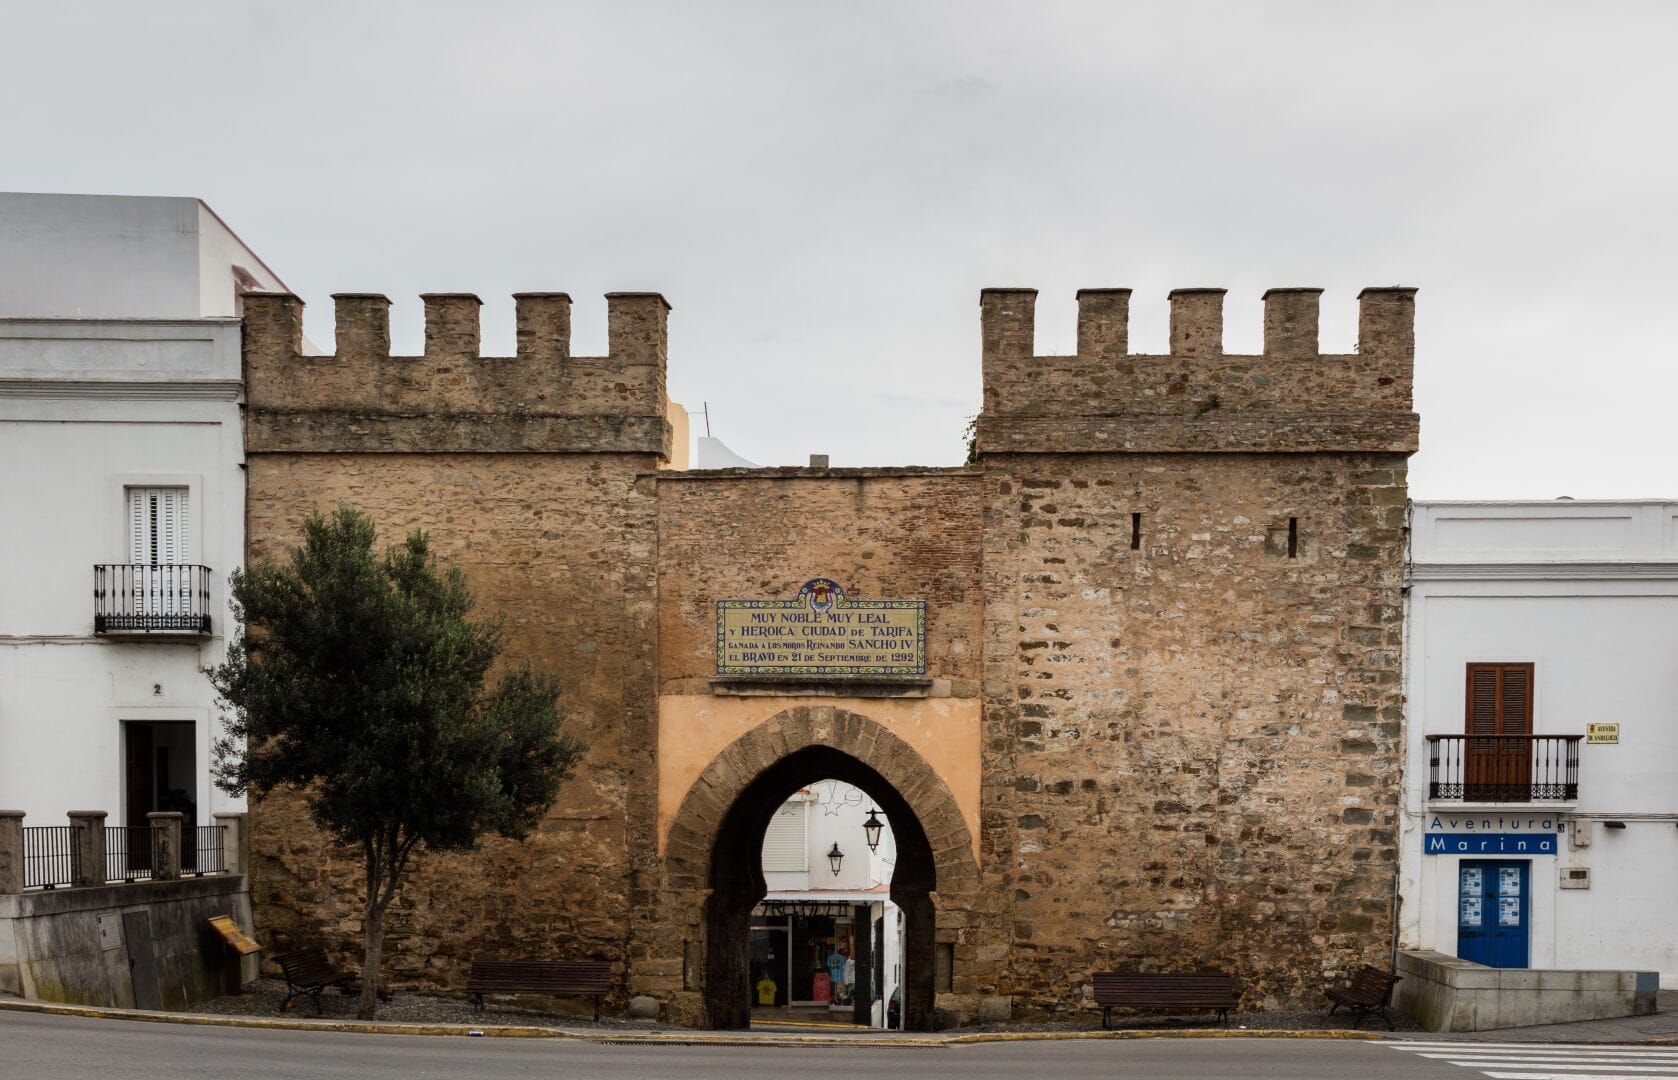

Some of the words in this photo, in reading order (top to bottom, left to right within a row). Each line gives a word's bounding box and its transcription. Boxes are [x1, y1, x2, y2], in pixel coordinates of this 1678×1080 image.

[751, 613, 777, 623] MUY
[781, 612, 822, 623] NOBLE
[827, 612, 854, 623] MUY
[858, 613, 890, 624] LEAL
[729, 628, 736, 636] Y
[741, 626, 794, 637] HEROICA
[802, 626, 846, 637] CIUDAD
[851, 629, 865, 637] DE
[871, 626, 913, 638] TARIFA
[767, 642, 781, 650] LOS
[783, 642, 806, 650] MOROS
[848, 640, 897, 650] SANCHO
[900, 640, 913, 650] IV
[729, 654, 740, 662] EL
[742, 652, 775, 662] BRAVO
[777, 654, 789, 662] EN
[791, 652, 801, 662] 21
[804, 654, 815, 662] DE
[891, 653, 914, 662] 1292
[1430, 816, 1552, 830] Aventura
[1430, 837, 1550, 851] Marina
